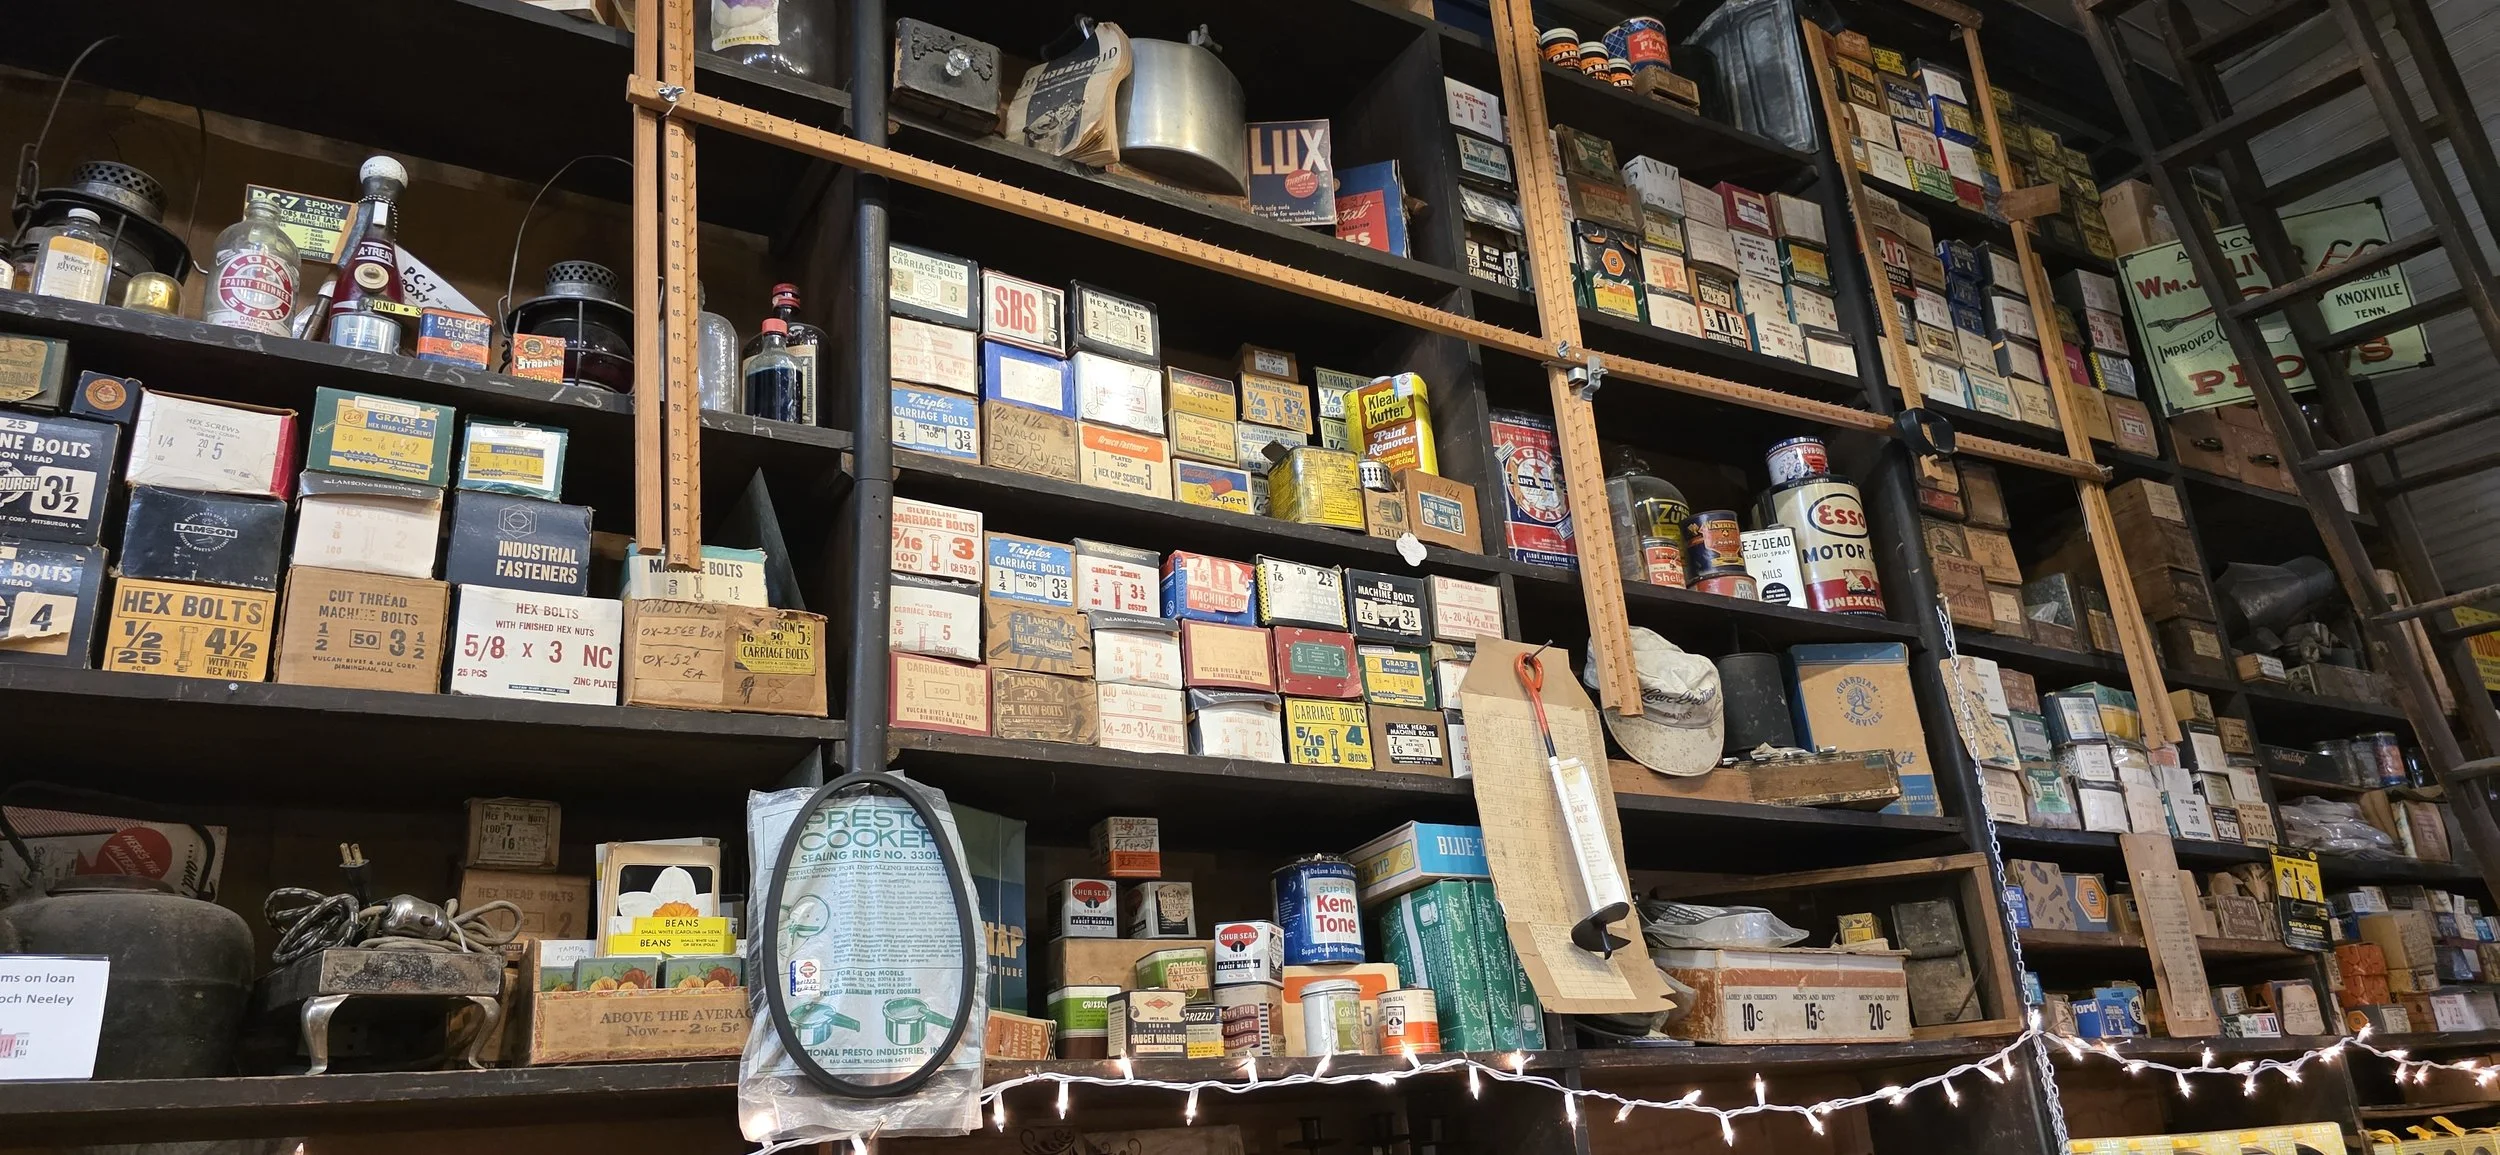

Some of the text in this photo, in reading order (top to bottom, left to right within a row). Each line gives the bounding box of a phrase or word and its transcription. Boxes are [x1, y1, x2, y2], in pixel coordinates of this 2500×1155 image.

[1250, 128, 1328, 175] LUX
[1463, 153, 1489, 167] CARRIAGE
[304, 200, 343, 212] EPOXY
[307, 208, 341, 218] PASTE
[892, 256, 963, 280] CARRIAGE BOLTS
[931, 259, 956, 269] PLATED
[1469, 267, 1497, 282] CARRIAGE
[225, 279, 291, 302] PAINT THINNER
[2335, 282, 2403, 308] KNOXVILLE
[994, 285, 1037, 334] SBS
[1090, 298, 1145, 320] HEX BOLTS
[2353, 306, 2391, 319] TENN.
[1707, 331, 1731, 344] CARRIAGE
[1319, 372, 1353, 389] CARRIAGE
[1189, 387, 1219, 401] Xpert
[1245, 381, 1302, 399] CARRIAGE BOLTS
[907, 393, 953, 410] Triplex
[376, 413, 428, 428] GRADE 2
[894, 406, 969, 426] CARRIAGE BOLTS
[1370, 404, 1405, 424] Kutter
[1374, 425, 1407, 442] Paint
[32, 437, 91, 459] BOLTS
[1368, 434, 1416, 456] Remover
[24, 454, 53, 464] HEAD
[1098, 467, 1144, 486] HEX CAP SCREWS
[906, 506, 957, 520] SILVERLINE
[176, 524, 236, 537] LAMSON
[946, 520, 975, 533] BOLTS
[498, 540, 579, 565] INDUSTRIAL
[1007, 542, 1052, 561] Triplex
[1802, 543, 1865, 564] MOTOR
[12, 561, 73, 583] BOLTS
[496, 559, 578, 584] FASTENERS
[710, 563, 743, 578] BOLTS
[995, 555, 1066, 575] CARRIAGE BOLTS
[1091, 566, 1141, 580] CARRIAGE SCREWS
[1762, 568, 1782, 580] KILLS
[3, 578, 33, 588] HEAD
[329, 590, 408, 608] CUT THREAD
[1190, 589, 1229, 606] MACHINE
[1358, 586, 1414, 604] MACHINE BOLTS
[123, 590, 262, 625] HEX BOLTS
[516, 603, 579, 619] HEX BOLTS
[894, 606, 952, 619] CARRIAGE SCREWS
[381, 611, 419, 625] BOLTS
[496, 620, 595, 637] WITH FINISHED HEX NUTS
[118, 650, 161, 665] 25
[464, 633, 613, 669] 5/8 3 NC
[743, 645, 809, 660] CARRIAGE BOLTS
[208, 657, 230, 667] WITH
[206, 667, 249, 679] HEX NUTS
[457, 668, 488, 678] 25 PCS
[907, 662, 982, 679] CARRIAGE BOLTS
[573, 677, 617, 689] ZINC PLATE
[1836, 676, 1879, 696] GUARDIAN
[1294, 704, 1365, 723] CARRIAGE BOLTS
[1844, 710, 1883, 727] SERVICE
[1295, 726, 1364, 746] 5/16 4
[801, 850, 907, 864] SEALING RING NO.
[478, 887, 498, 898] HEX
[506, 889, 534, 899] HEAD
[1074, 888, 1111, 897] SHUR SEAL
[1319, 885, 1351, 894] SUPER
[665, 918, 699, 928] BEANS
[1316, 915, 1356, 933] Tone
[1220, 931, 1257, 940] SHUR SEAL
[559, 945, 584, 953] TAMPA
[640, 939, 672, 948] BEANS
[24, 972, 75, 983] on loan
[1002, 967, 1023, 978] TUBE
[27, 994, 74, 1006] Neeley
[600, 1011, 653, 1025] ABOVE
[657, 1009, 689, 1021] THE
[626, 1025, 659, 1037] Now
[704, 1024, 717, 1033] for
[1226, 1021, 1254, 1032] FAUCET
[1131, 1033, 1186, 1044] FAUCET WASHERS
[1225, 1034, 1258, 1048] WASHERS
[840, 1047, 927, 1057] PRESTO INDUSTRIES,
